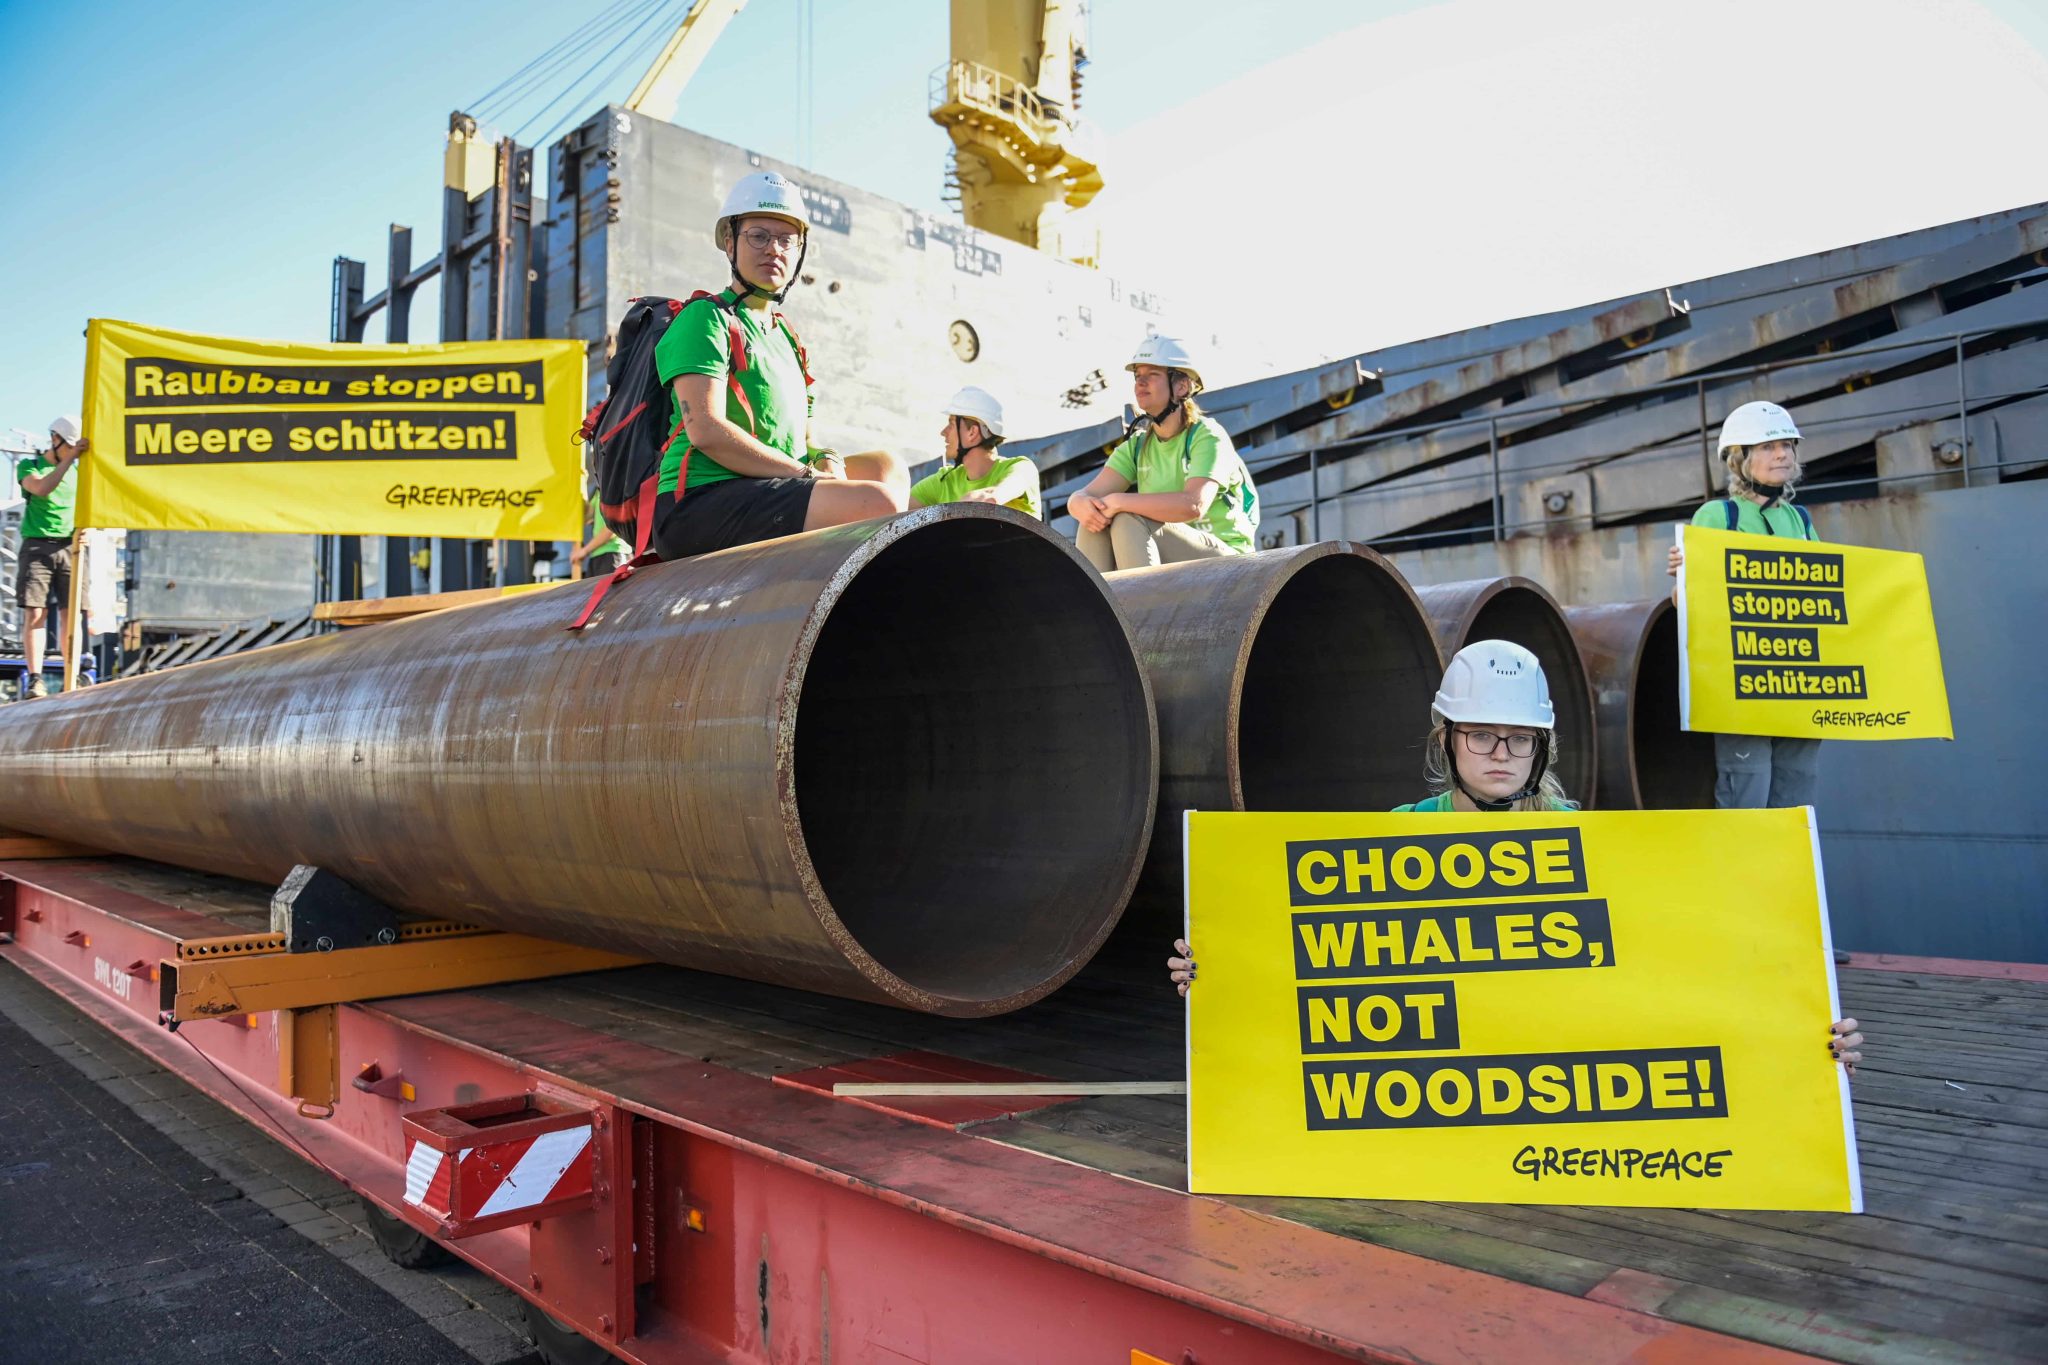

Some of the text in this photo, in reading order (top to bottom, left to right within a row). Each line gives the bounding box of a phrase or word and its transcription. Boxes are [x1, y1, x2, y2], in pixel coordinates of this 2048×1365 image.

[615, 113, 631, 134] 3
[134, 365, 536, 401] Raubbau stoppen,
[134, 418, 507, 455] Meere schützen!
[386, 484, 543, 508] GREENPEACE
[1730, 553, 1839, 583] Raubbau
[1732, 591, 1841, 622] stoppen,
[1736, 630, 1813, 657] Meere
[1739, 669, 1861, 694] schützen!
[1811, 709, 1911, 728] GREENPEACE
[1296, 838, 1575, 896] CHOOSE
[1298, 911, 1604, 969] WHALES,
[1307, 993, 1445, 1044] NOT
[1309, 1059, 1715, 1120] WOODSIDE!
[1512, 1145, 1733, 1182] GREENPEACE
